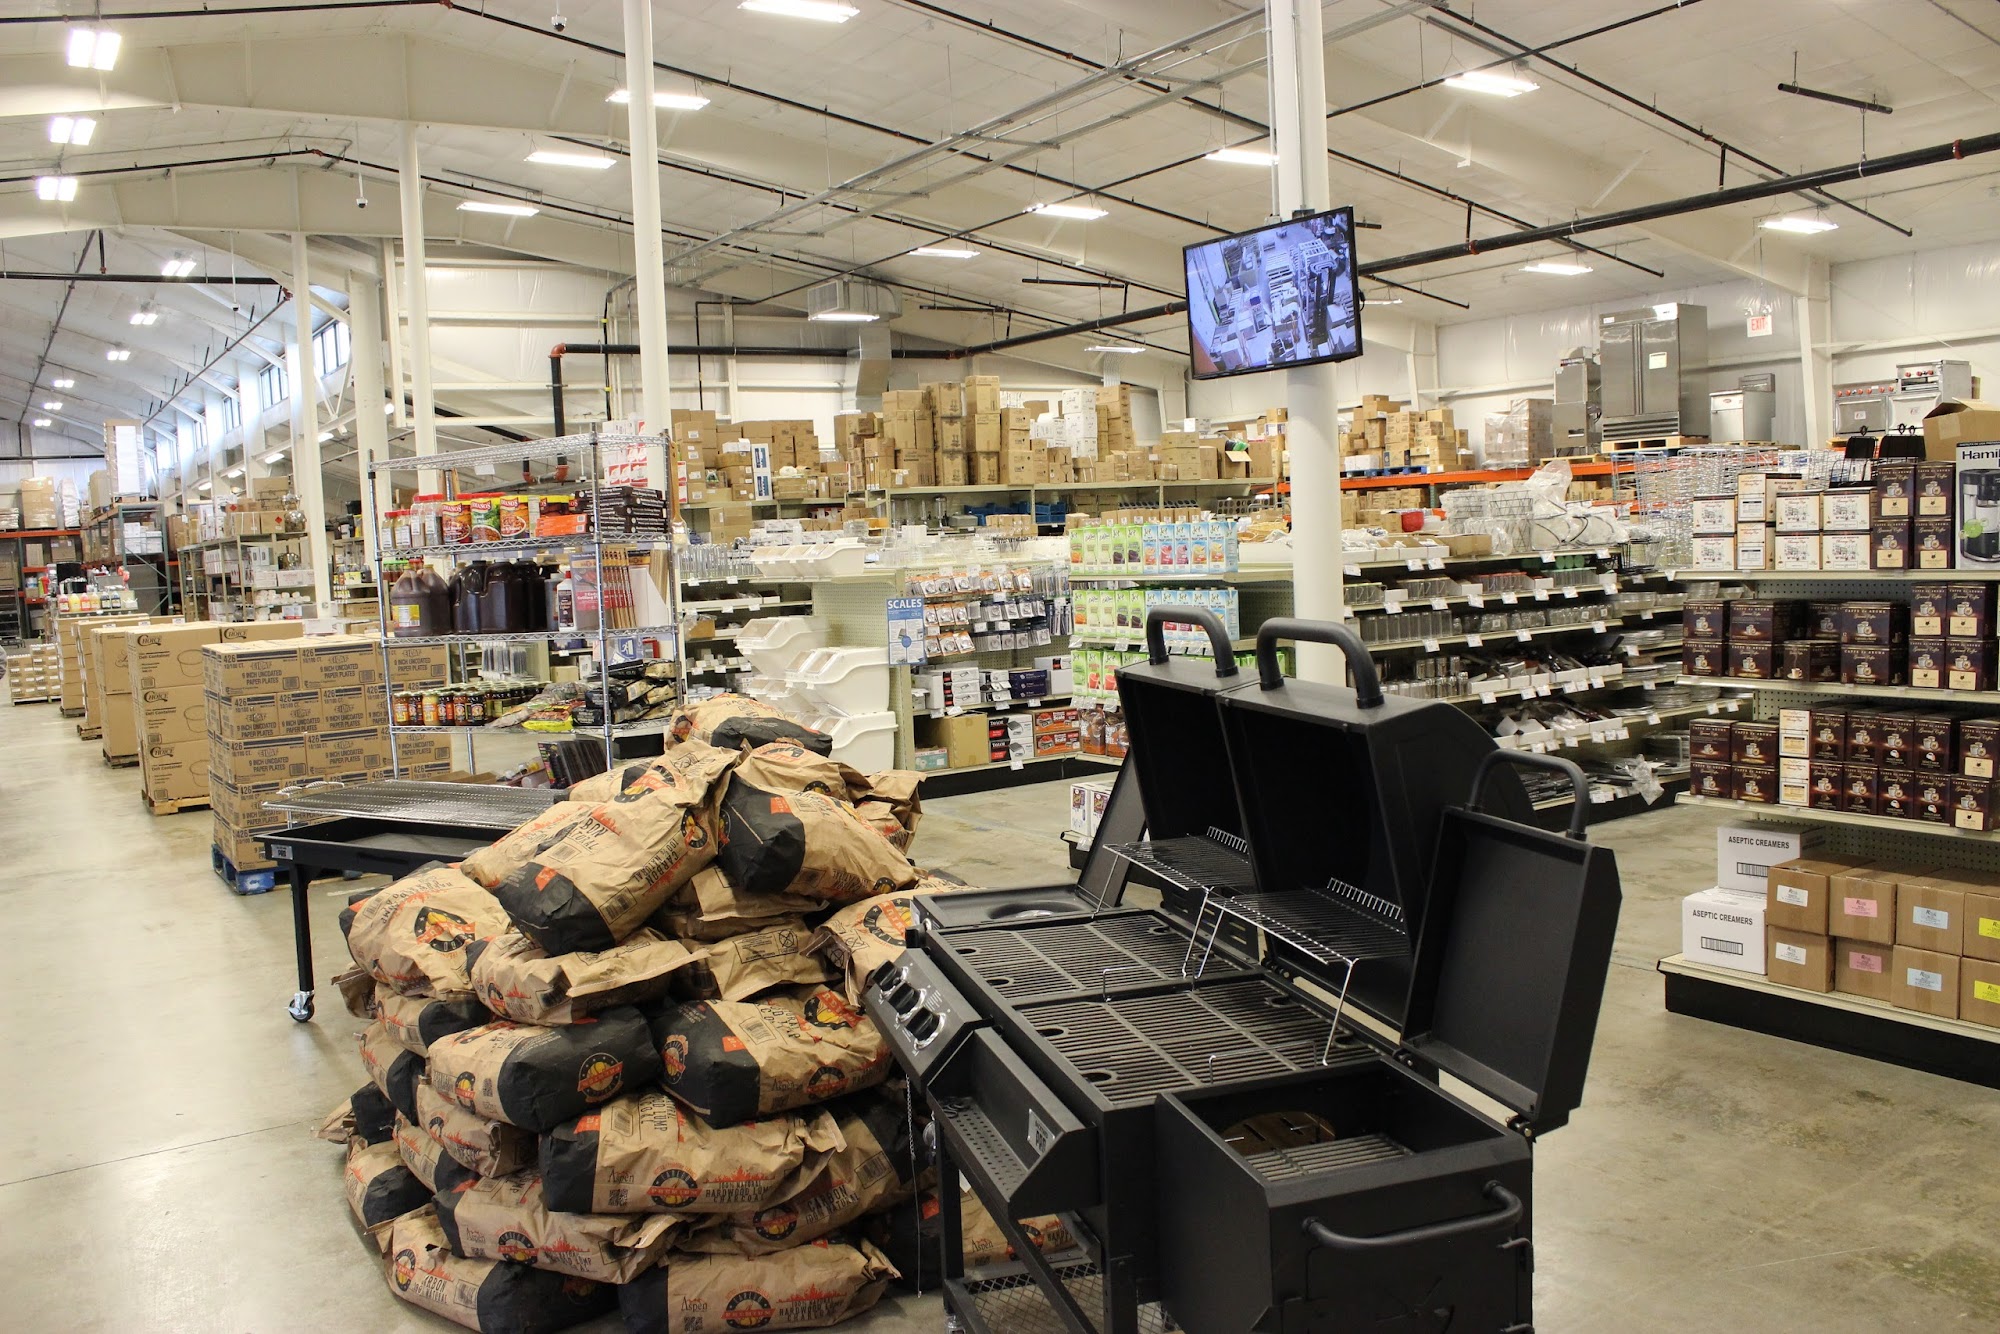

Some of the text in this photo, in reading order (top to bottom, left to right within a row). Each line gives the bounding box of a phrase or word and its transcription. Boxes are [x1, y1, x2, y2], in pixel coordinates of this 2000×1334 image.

[1752, 318, 1765, 330] EXIT
[888, 599, 922, 609] SCALES
[224, 655, 236, 663] 426
[302, 649, 314, 657] 426
[308, 735, 319, 743] 426
[231, 742, 242, 751] 426
[1728, 836, 1790, 849] ASEPTIC CREAMERS
[1692, 910, 1753, 926] ASEPTIC CREAMERS
[608, 1168, 635, 1184] Aspen
[706, 1188, 750, 1198] HARDWOOD
[808, 1185, 848, 1211] CARBON
[971, 1236, 994, 1252] Aspen
[681, 1296, 707, 1312] Aspen
